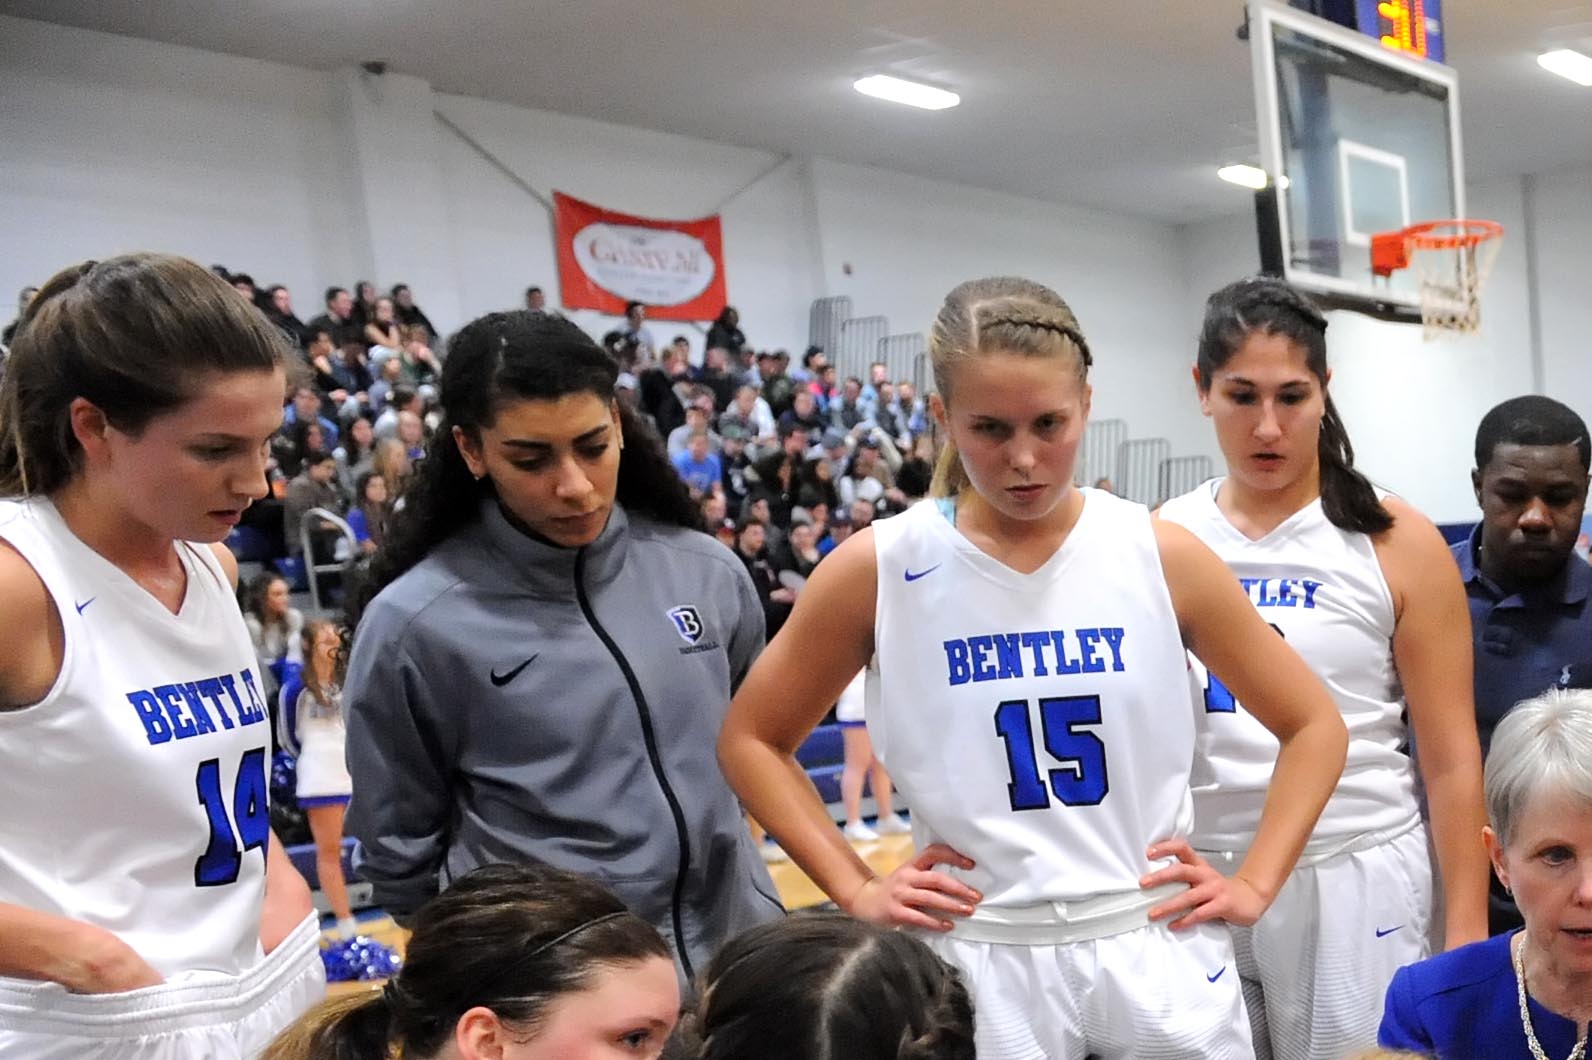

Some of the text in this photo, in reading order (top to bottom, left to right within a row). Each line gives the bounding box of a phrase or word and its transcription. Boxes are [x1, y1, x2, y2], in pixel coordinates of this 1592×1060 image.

[1237, 578, 1323, 609] TLEY
[943, 627, 1126, 686] BENTLEY
[126, 668, 269, 746] BENTLE
[994, 694, 1110, 812] 15
[194, 746, 270, 888] 14
